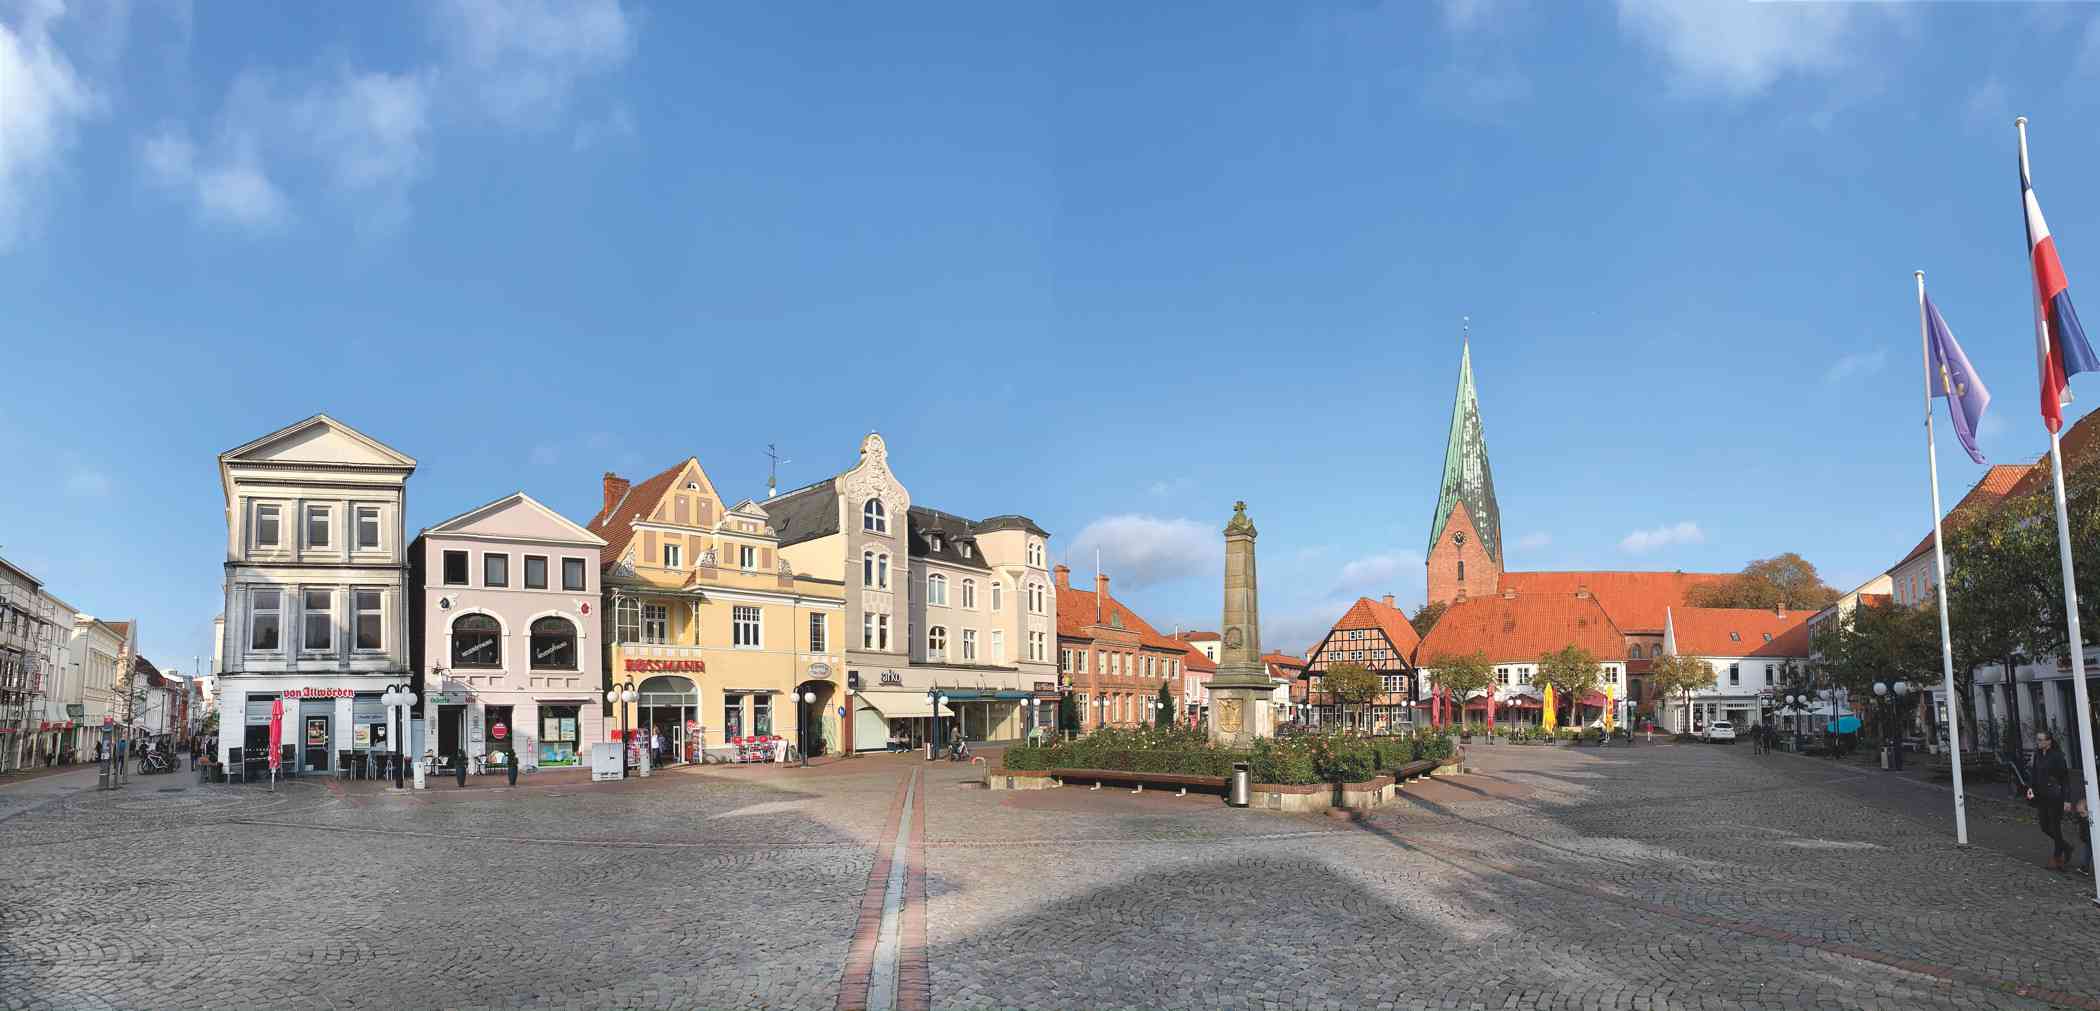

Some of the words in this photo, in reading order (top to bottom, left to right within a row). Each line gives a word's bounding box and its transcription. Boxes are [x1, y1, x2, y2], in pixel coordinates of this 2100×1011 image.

[625, 659, 705, 673] ROSSMANN
[881, 669, 901, 682] arko
[283, 690, 301, 698] von
[303, 687, 355, 698] Allwörden
